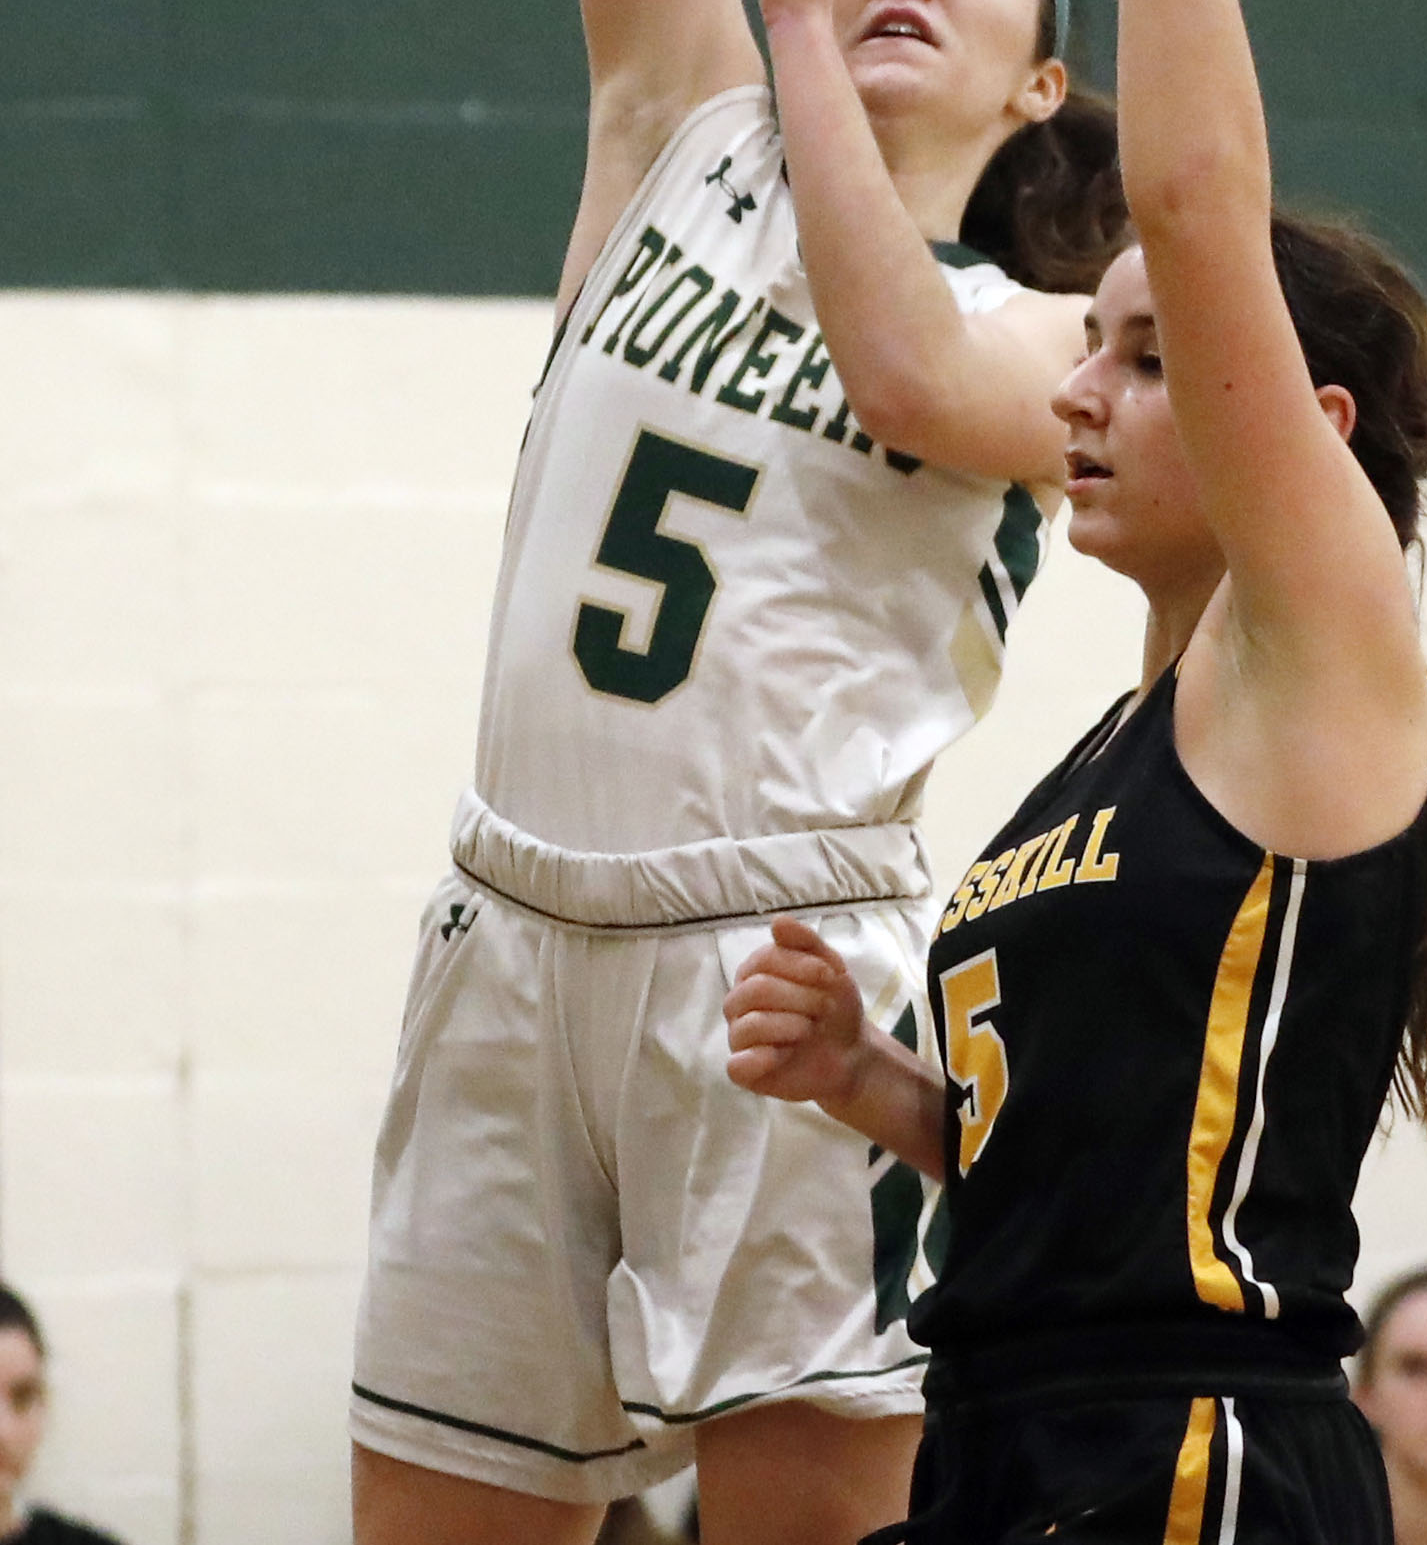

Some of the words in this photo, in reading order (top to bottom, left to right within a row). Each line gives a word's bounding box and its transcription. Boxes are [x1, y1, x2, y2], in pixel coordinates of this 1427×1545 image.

[581, 226, 921, 476] PIONEE
[570, 423, 764, 713] 5
[931, 805, 1120, 941] SSKILL
[939, 947, 1010, 1180] 5
